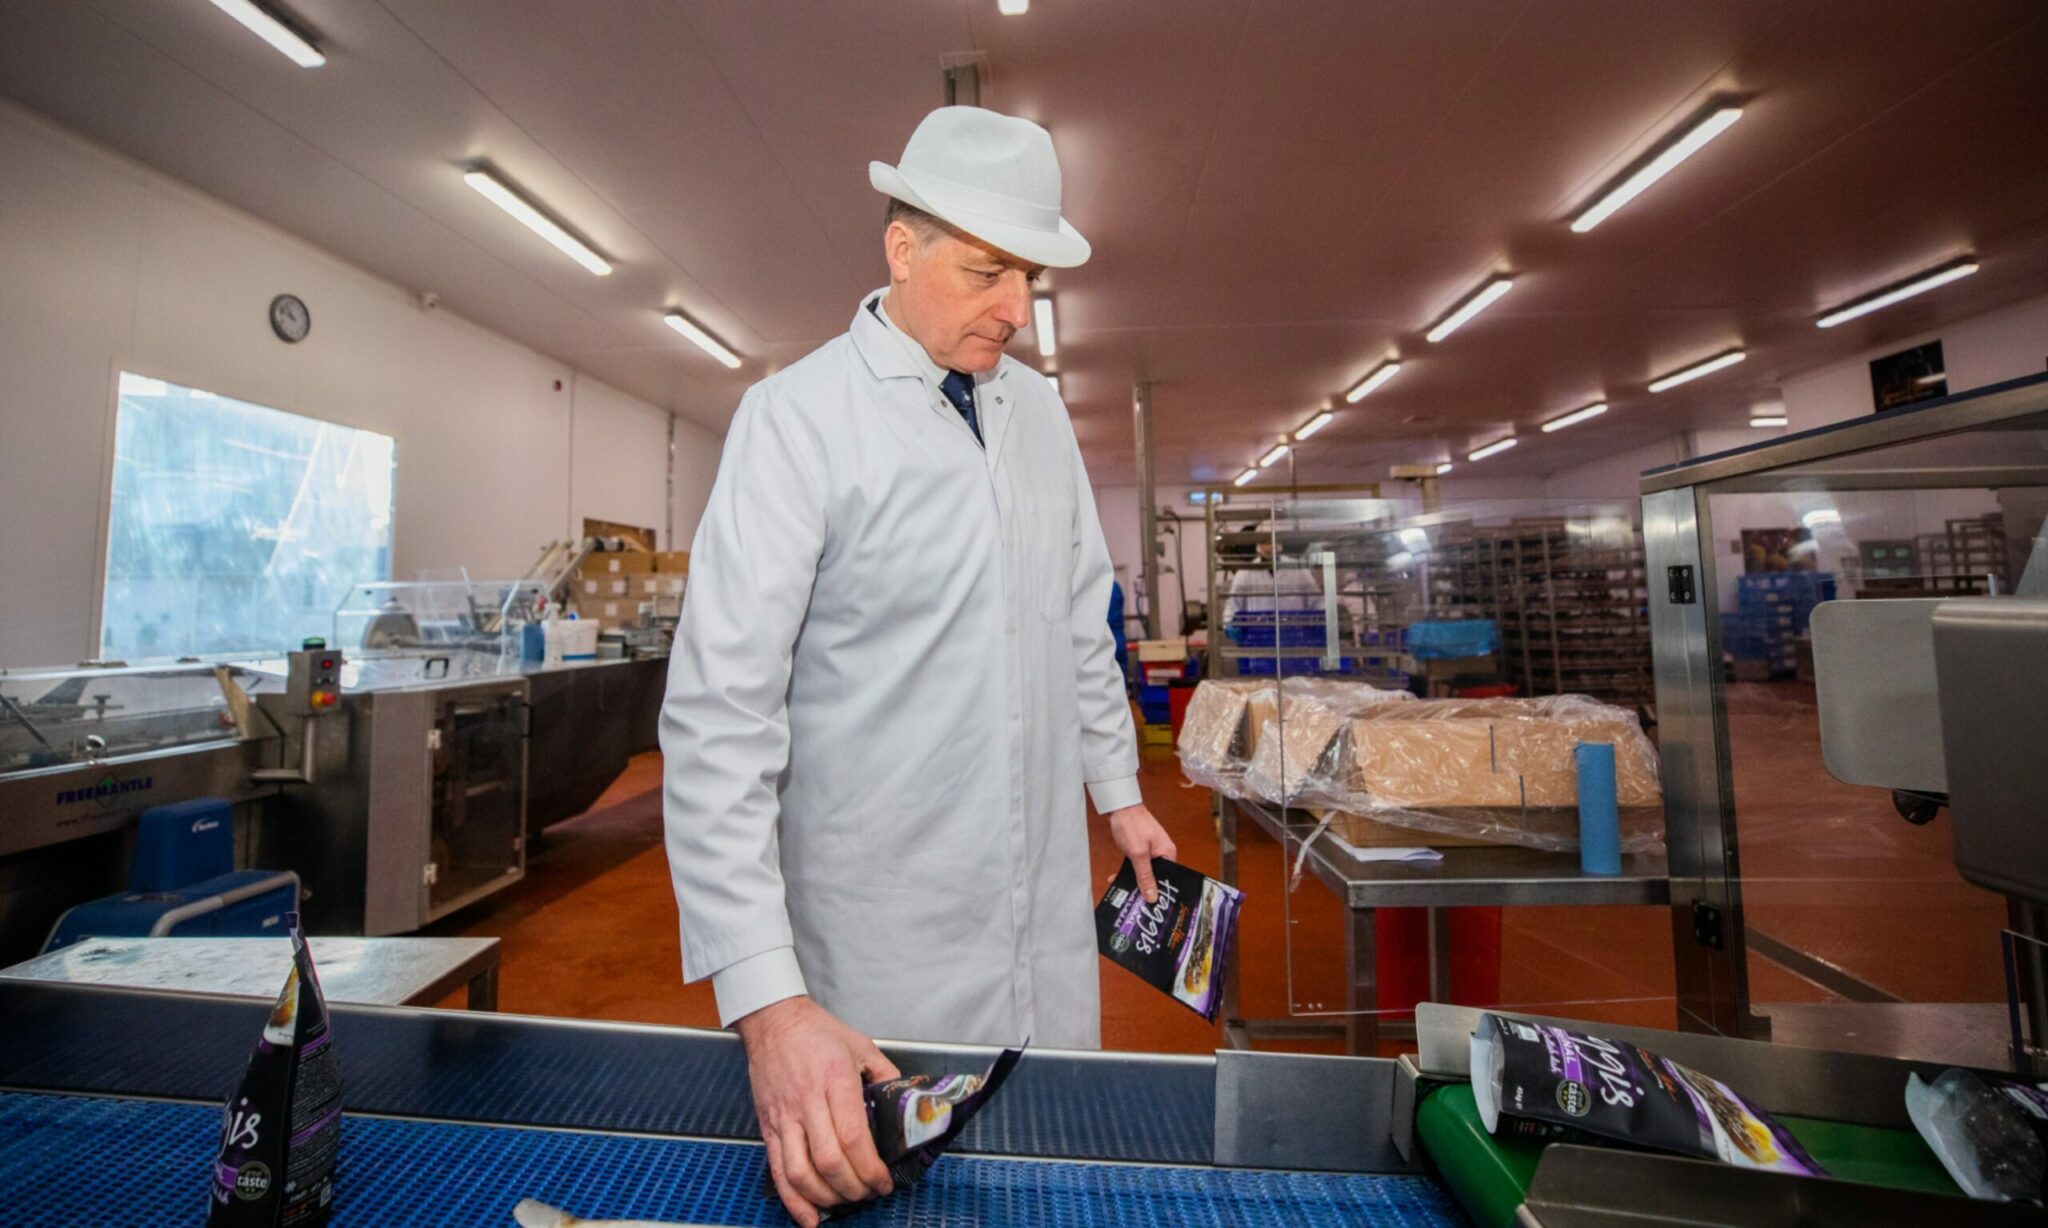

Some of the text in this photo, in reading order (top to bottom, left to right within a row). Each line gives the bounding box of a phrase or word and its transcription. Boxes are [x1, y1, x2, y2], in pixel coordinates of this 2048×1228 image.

[56, 776, 153, 805] FREEMANTLE
[1135, 879, 1179, 954] Haggis
[1568, 1035, 1645, 1108] ggis
[1567, 1082, 1578, 1113] taste
[237, 1175, 268, 1188] taste
